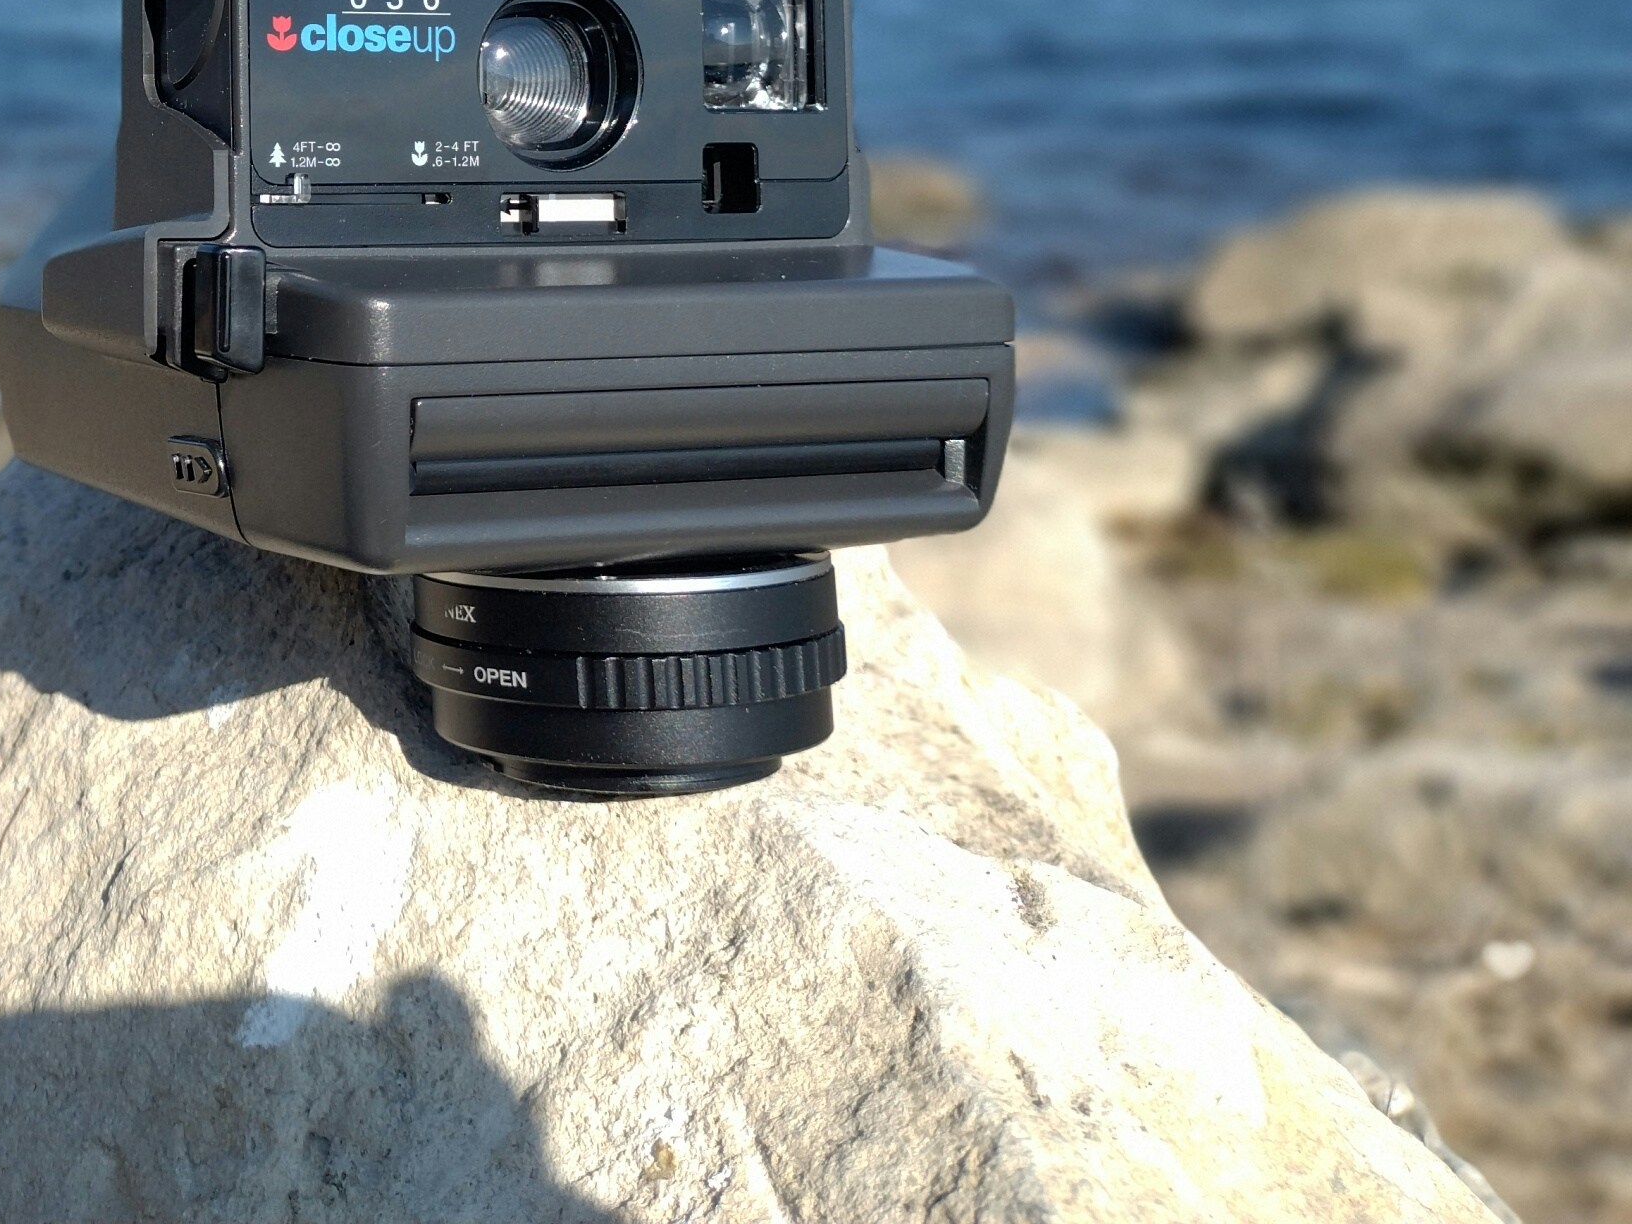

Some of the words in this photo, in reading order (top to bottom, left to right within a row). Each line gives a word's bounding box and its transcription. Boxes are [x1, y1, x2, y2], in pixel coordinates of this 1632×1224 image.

[300, 13, 456, 62] closeup
[463, 141, 479, 152] FT
[473, 666, 528, 689] OPEN
